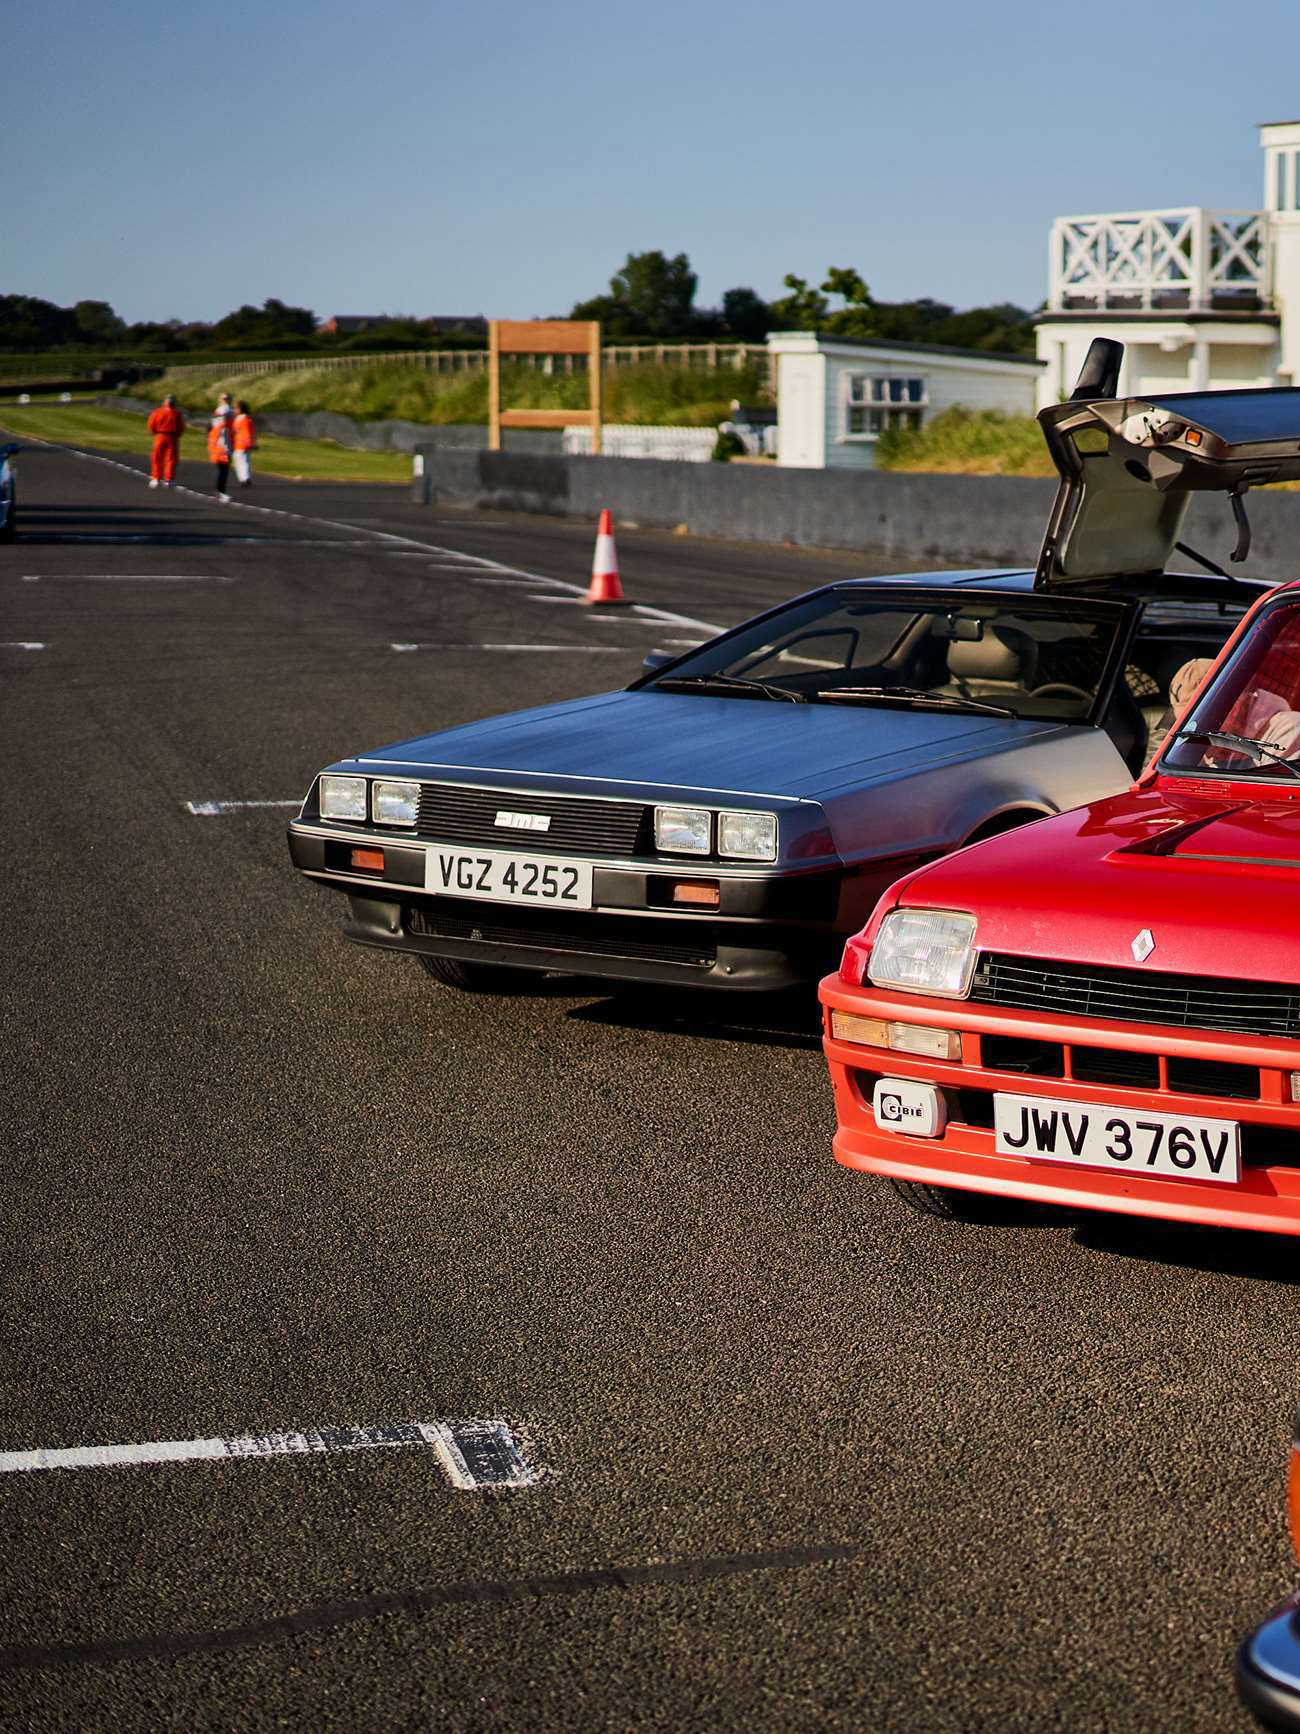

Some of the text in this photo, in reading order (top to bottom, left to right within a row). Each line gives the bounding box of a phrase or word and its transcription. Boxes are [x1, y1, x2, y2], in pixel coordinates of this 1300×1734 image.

[439, 854, 579, 900] VGZ 4252
[1002, 1106, 1229, 1174] JWV 376V
